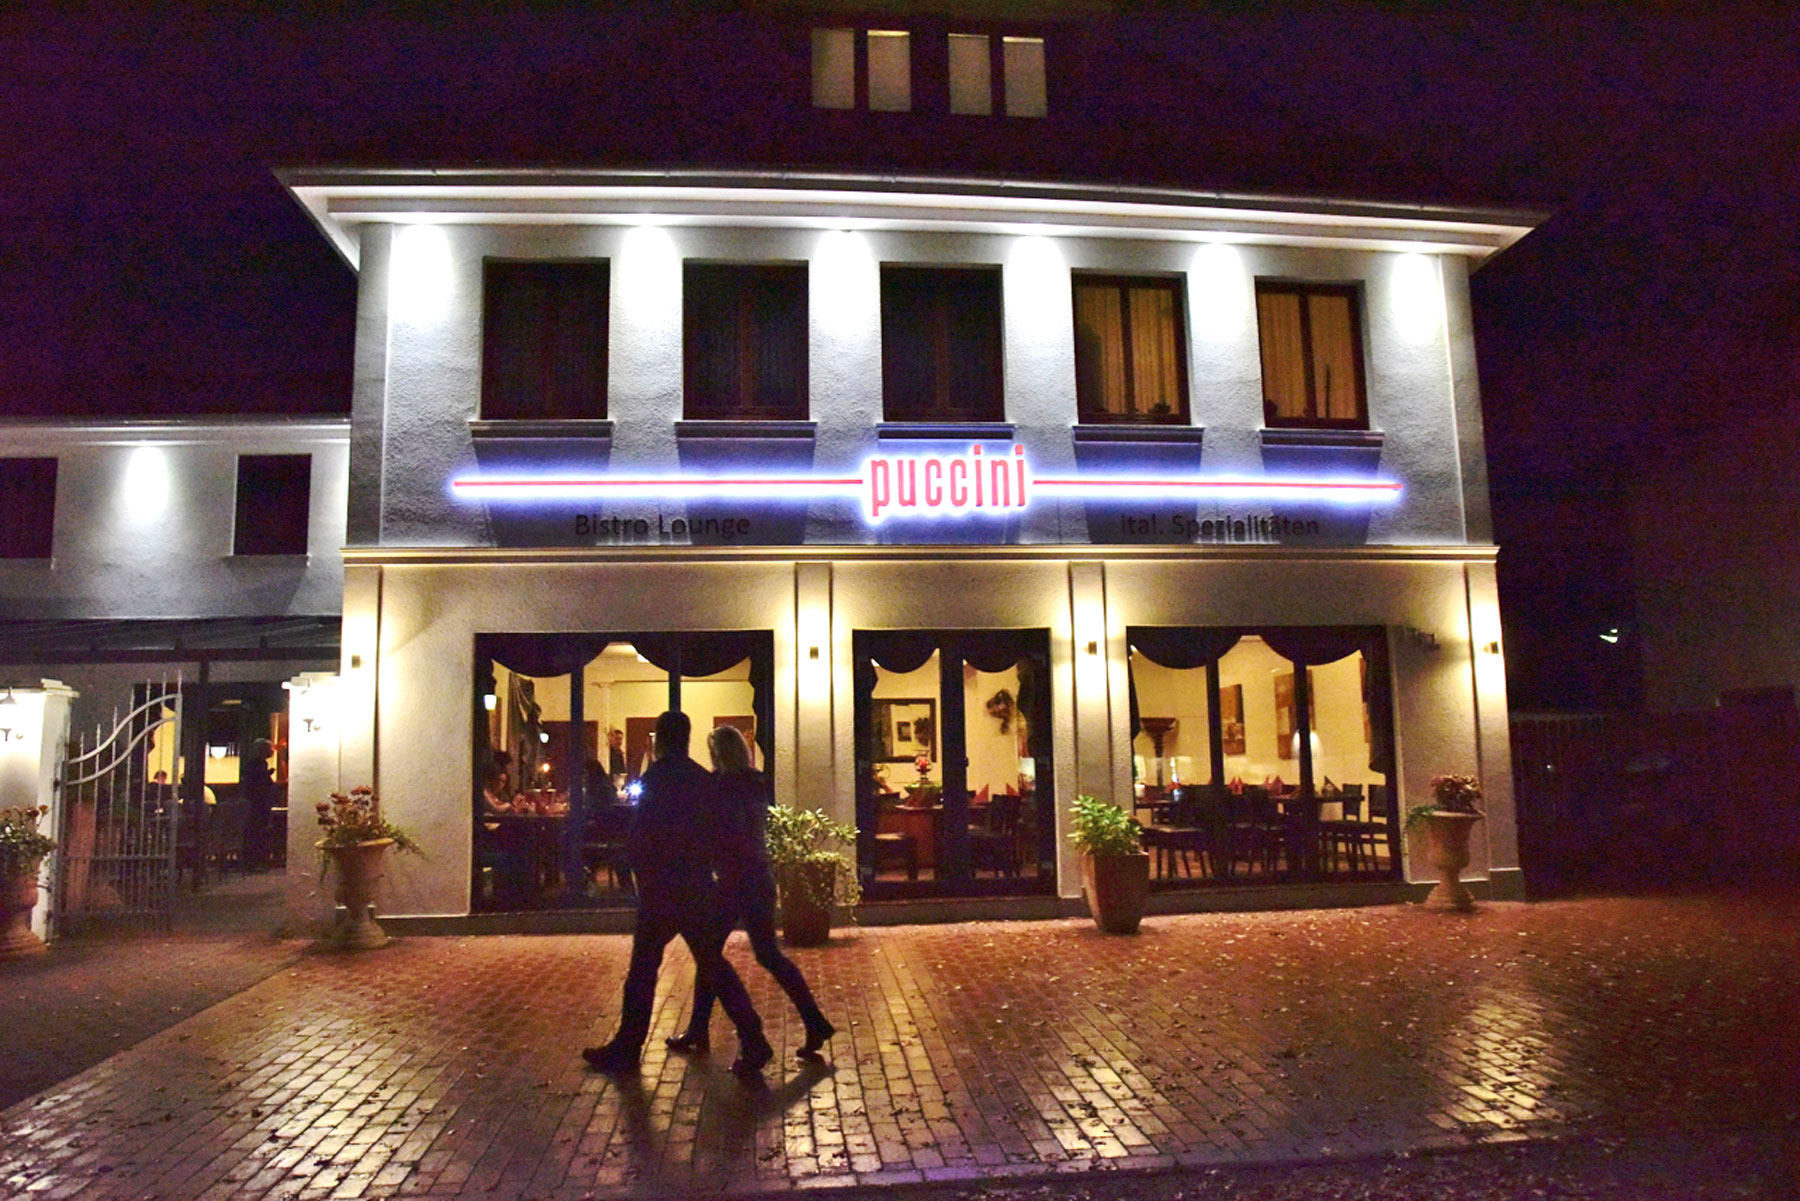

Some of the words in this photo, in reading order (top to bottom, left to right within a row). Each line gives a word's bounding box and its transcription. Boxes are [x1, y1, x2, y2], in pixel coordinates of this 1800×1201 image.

[870, 444, 1026, 517] puccini
[575, 514, 649, 536] Bistro
[659, 514, 750, 540] Lounge
[1120, 513, 1163, 535] ital.
[1172, 513, 1319, 538] Spezialitäten
